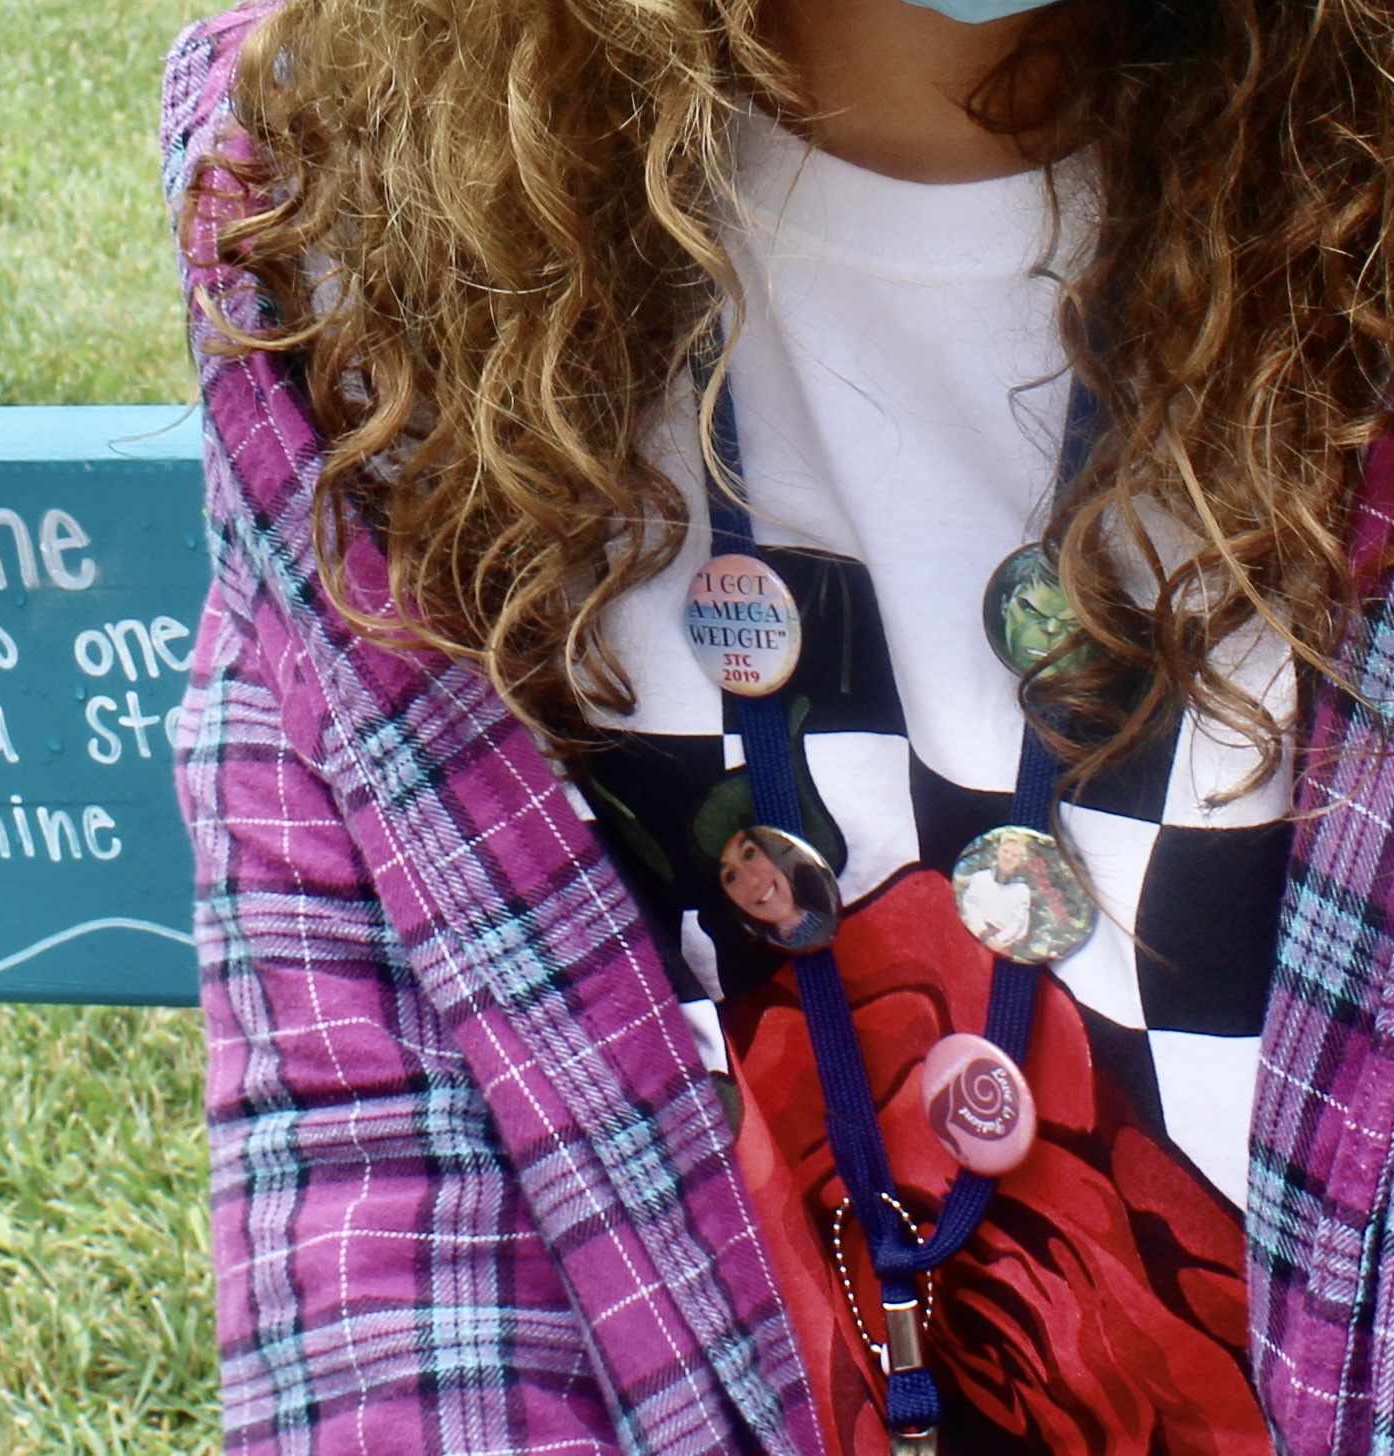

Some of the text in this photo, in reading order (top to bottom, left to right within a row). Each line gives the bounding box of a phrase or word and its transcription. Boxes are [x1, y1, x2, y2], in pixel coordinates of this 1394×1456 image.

[720, 573, 767, 595] GOT
[689, 599, 783, 623] A MEGA
[74, 615, 195, 682] one
[722, 669, 760, 683] 2019
